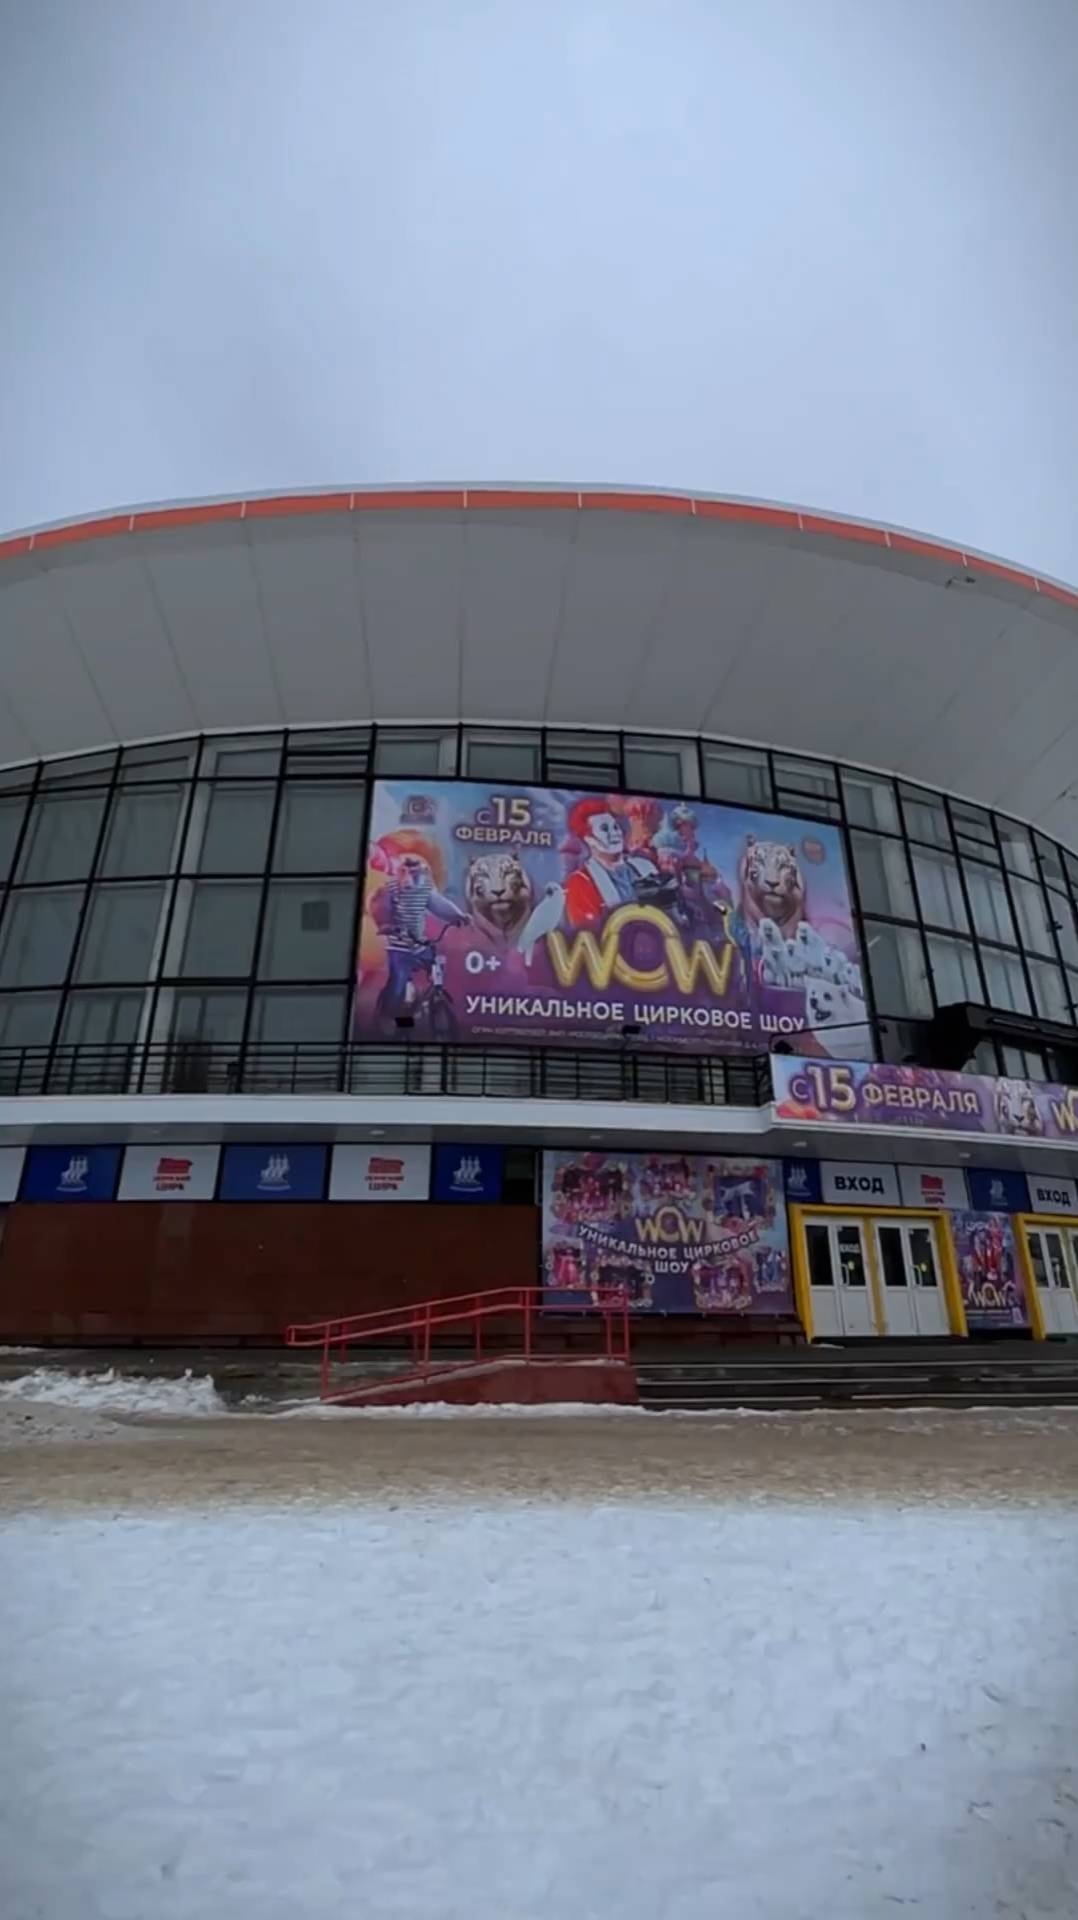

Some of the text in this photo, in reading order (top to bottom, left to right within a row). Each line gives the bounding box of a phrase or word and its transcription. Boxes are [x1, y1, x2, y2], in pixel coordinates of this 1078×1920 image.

[492, 797, 532, 826] 15
[456, 826, 552, 846] ФЕВРАЛЯ
[465, 950, 501, 973] 0+
[547, 903, 737, 996] WOW
[466, 995, 805, 1032] УНИКАЛЬНОЕ ЦИРКОВОЕ ШОУ
[806, 1065, 856, 1111] 15
[862, 1082, 981, 1115] ФЕВРАЛЯ
[834, 1176, 884, 1194] ВХОД
[1036, 1188, 1072, 1207] ВХОД
[635, 1206, 704, 1243] WOW
[578, 1226, 757, 1259] УНИКАЛЬНОЕ ЦИРКОВОЕ
[654, 1261, 689, 1274] ШОУ
